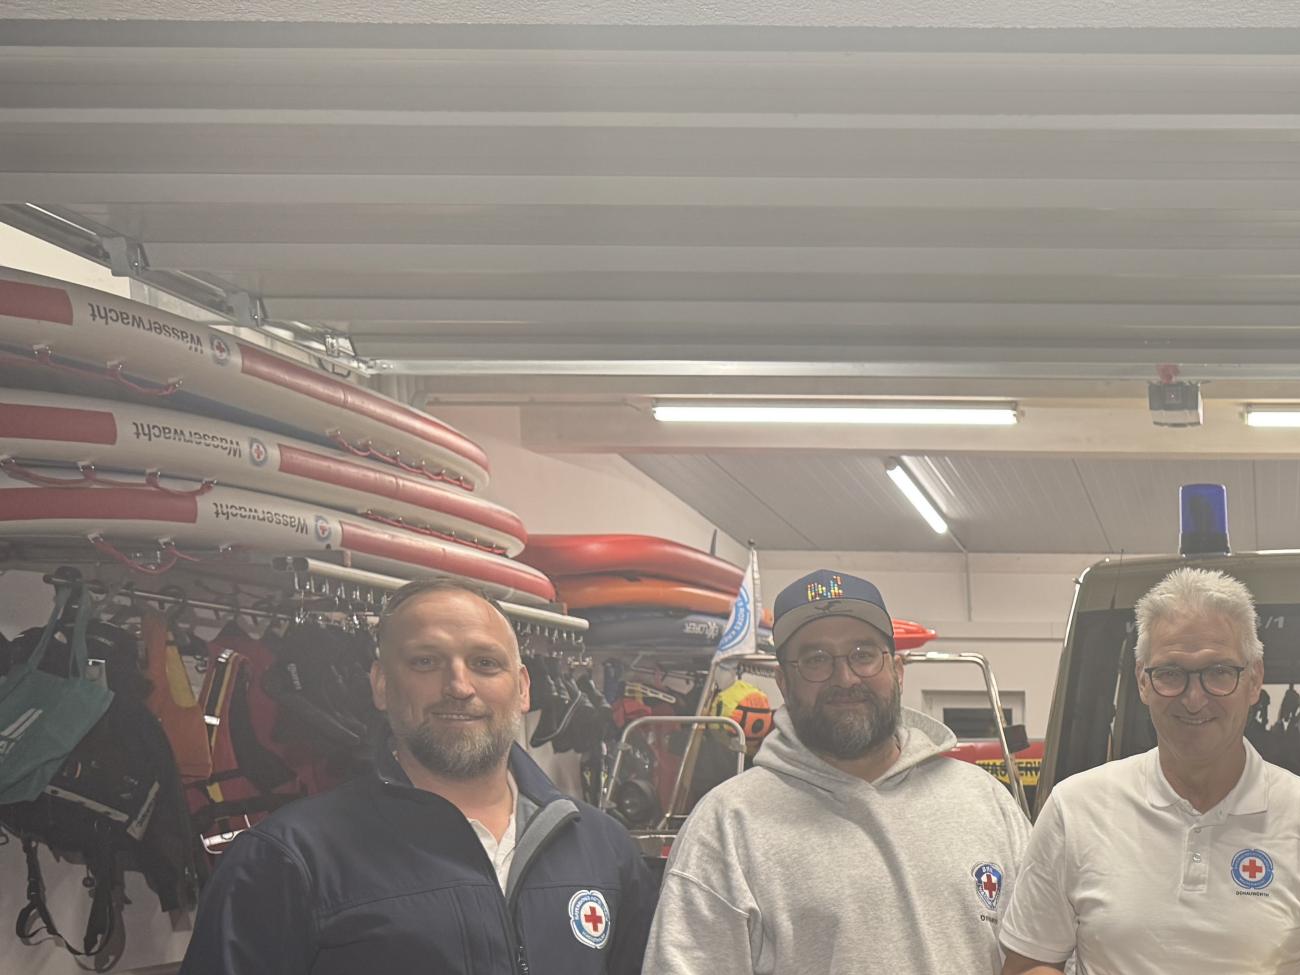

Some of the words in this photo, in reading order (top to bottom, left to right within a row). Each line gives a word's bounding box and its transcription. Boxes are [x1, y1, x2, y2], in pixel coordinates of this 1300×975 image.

[89, 302, 205, 355] Wasserwacht
[132, 421, 243, 459] Wasserwacht
[212, 501, 310, 536] Wasserwacht
